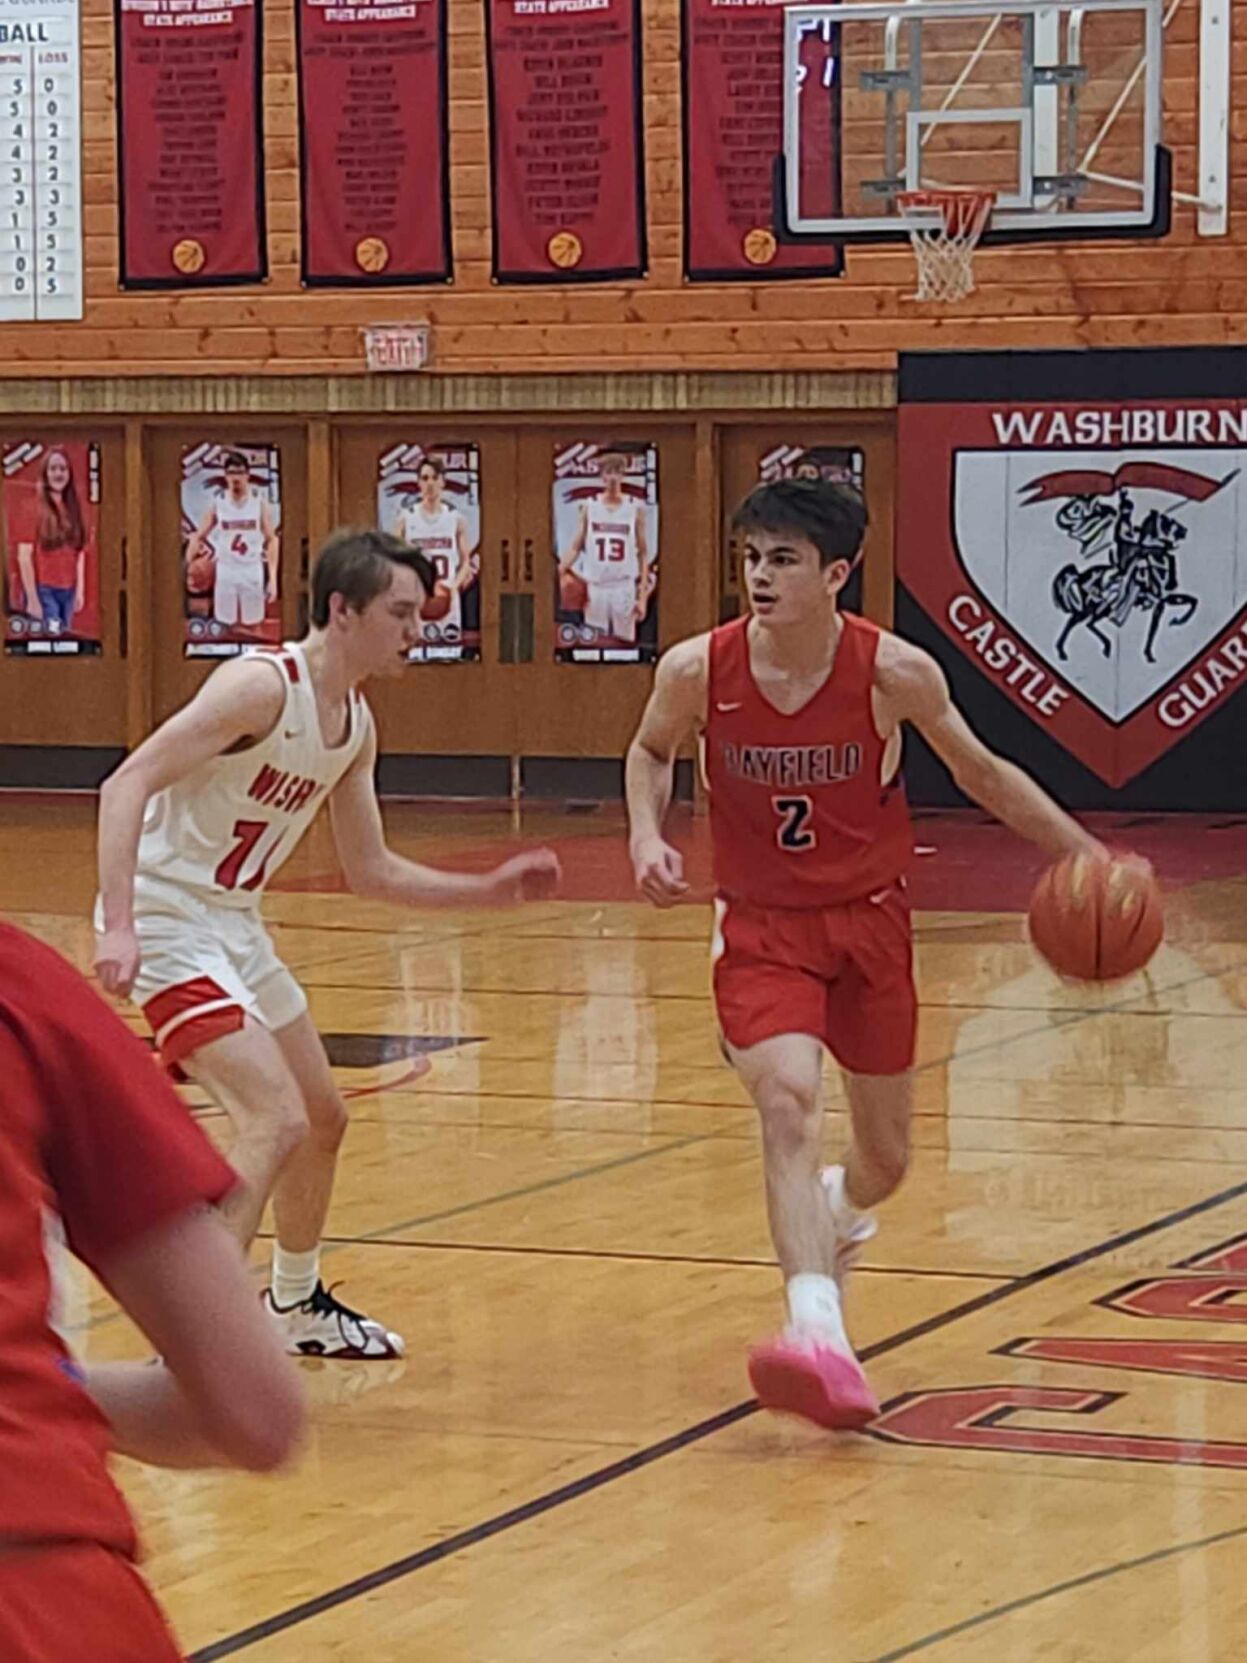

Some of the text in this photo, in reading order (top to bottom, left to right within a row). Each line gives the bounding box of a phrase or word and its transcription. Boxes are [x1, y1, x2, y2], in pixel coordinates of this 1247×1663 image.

[44, 78, 54, 93] 0
[47, 100, 57, 116] 0
[48, 122, 58, 138] 2
[48, 145, 58, 160] 2
[48, 166, 58, 181] 2
[49, 189, 60, 205] 3
[47, 211, 57, 226] 5
[46, 234, 56, 249] 5
[46, 256, 56, 272] 2
[47, 277, 57, 293] 5
[992, 409, 1247, 443] WASHBURN
[230, 533, 248, 556] 4
[595, 537, 626, 562] 13
[948, 595, 1070, 716] CASTLE
[1158, 620, 1247, 727] GUAR
[771, 794, 817, 850] 2
